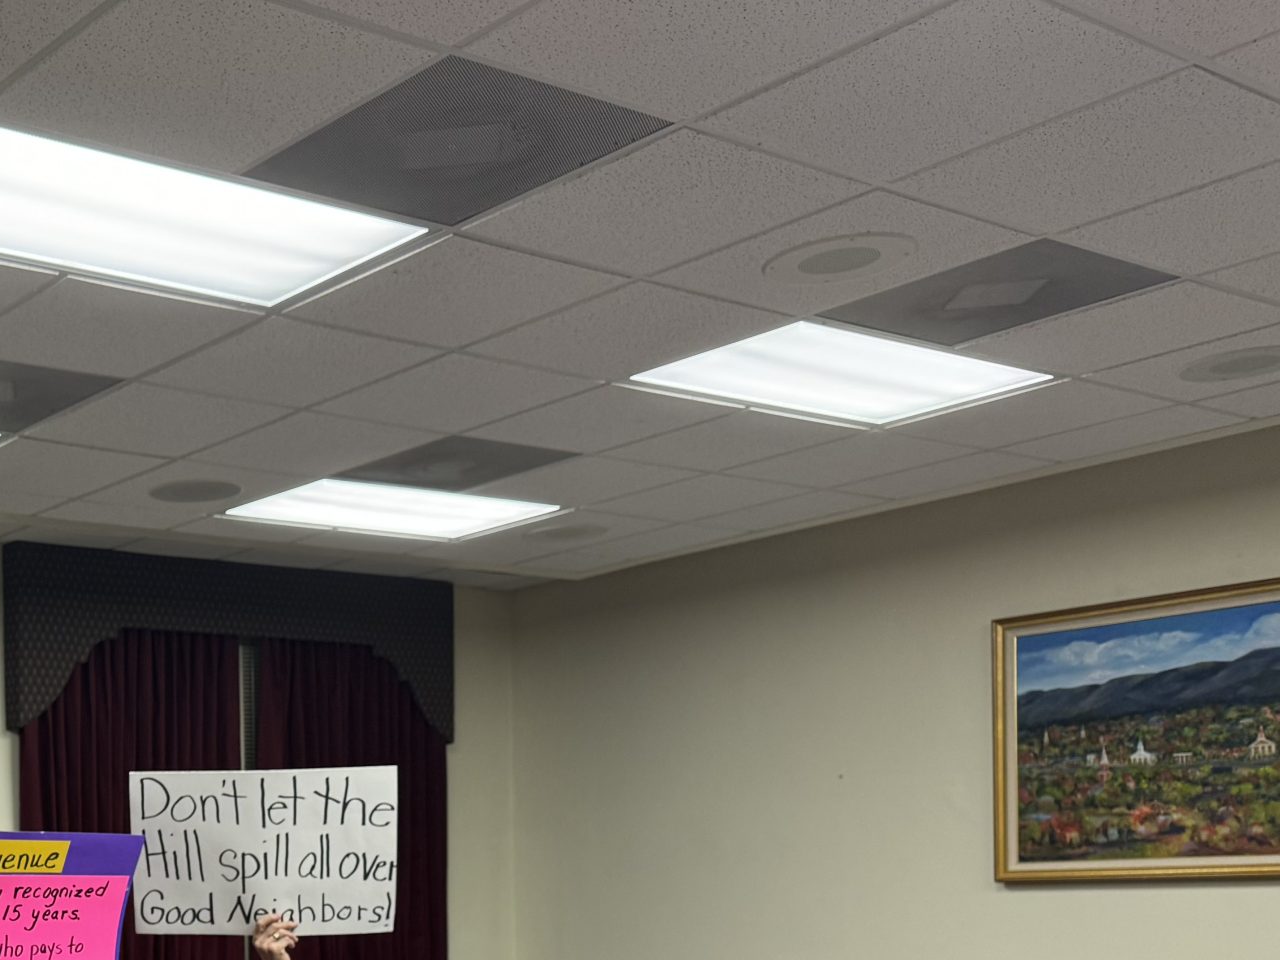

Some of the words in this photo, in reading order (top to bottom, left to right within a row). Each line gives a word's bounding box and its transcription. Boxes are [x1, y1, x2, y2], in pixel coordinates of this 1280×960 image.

[140, 776, 247, 825] Don't
[261, 775, 306, 828] let
[313, 776, 395, 827] the
[141, 829, 204, 882] Hill
[219, 832, 289, 894] spill
[298, 833, 330, 880] all
[338, 851, 397, 882] over
[13, 880, 110, 908] recognized
[140, 889, 214, 925] Good
[2, 904, 21, 921] 15
[24, 905, 81, 931] years.
[67, 936, 83, 954] to
